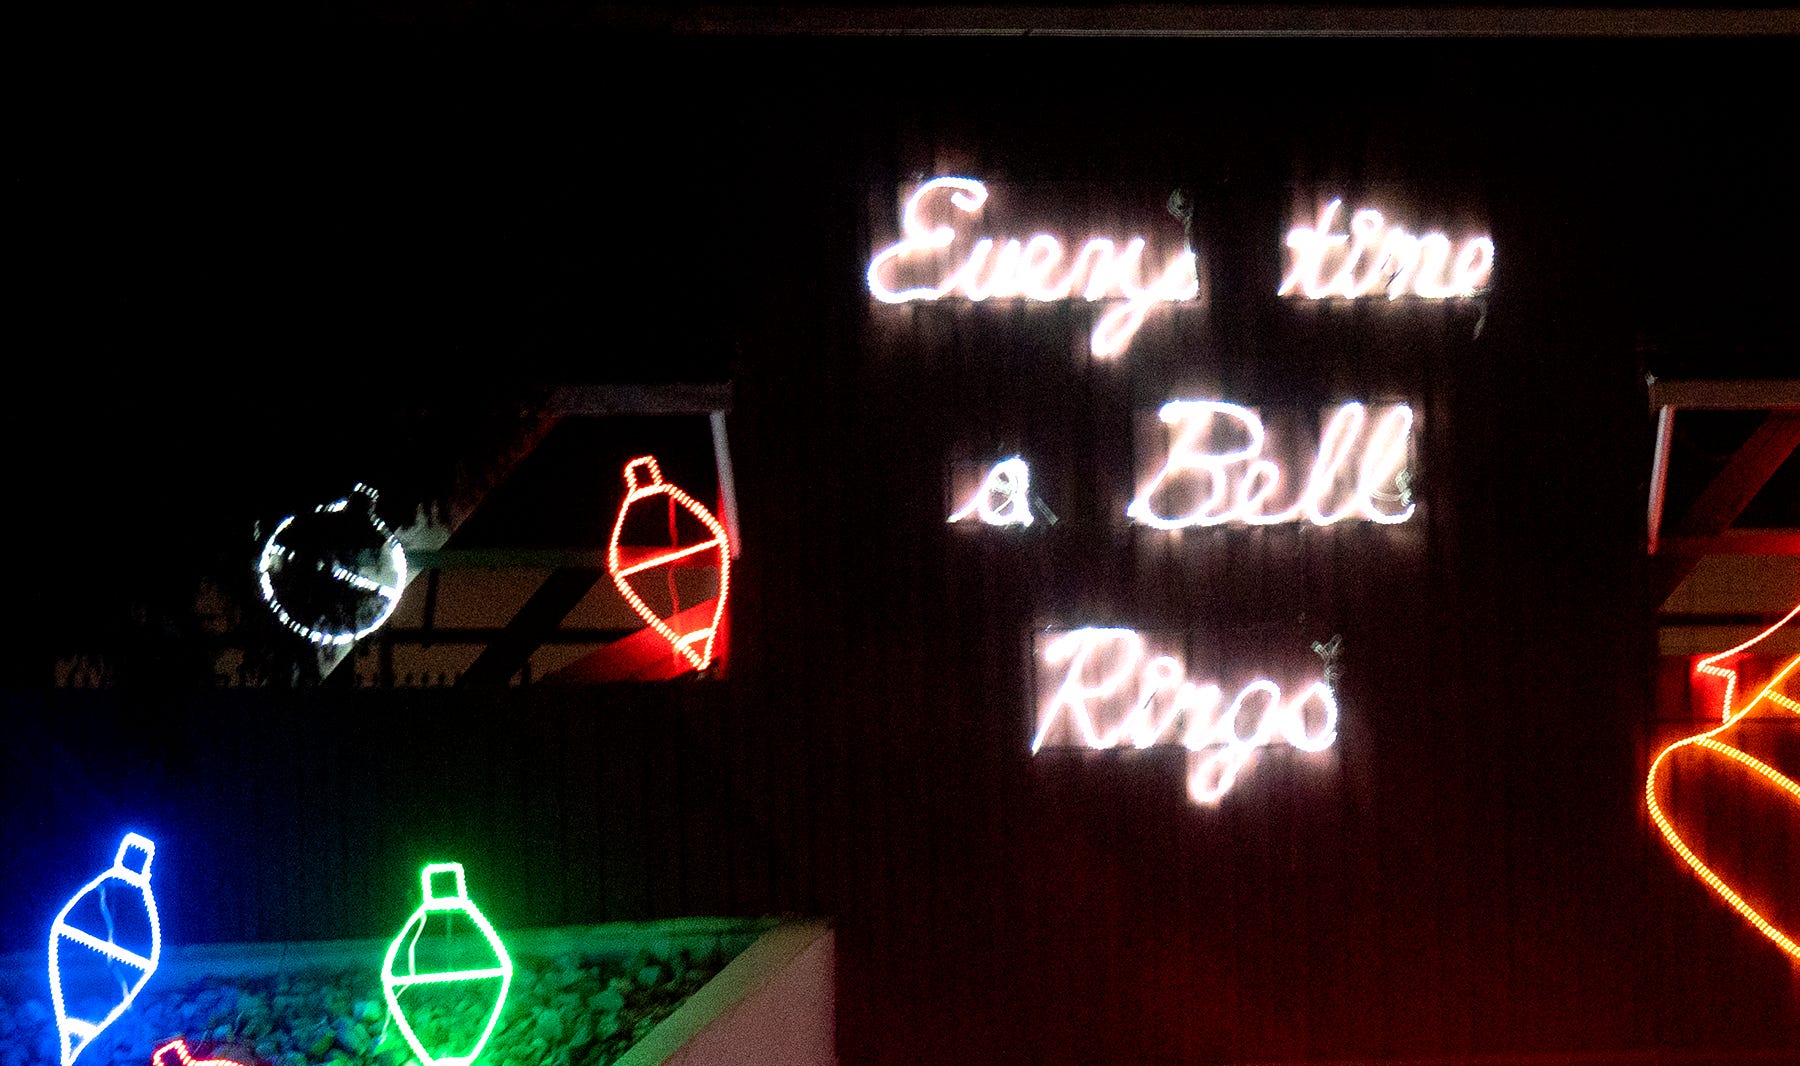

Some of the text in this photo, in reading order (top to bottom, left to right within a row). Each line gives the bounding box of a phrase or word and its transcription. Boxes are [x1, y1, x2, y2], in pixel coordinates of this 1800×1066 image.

[866, 175, 1495, 358] Every time
[947, 399, 1416, 530] a Bell
[1031, 625, 1338, 807] Rings
